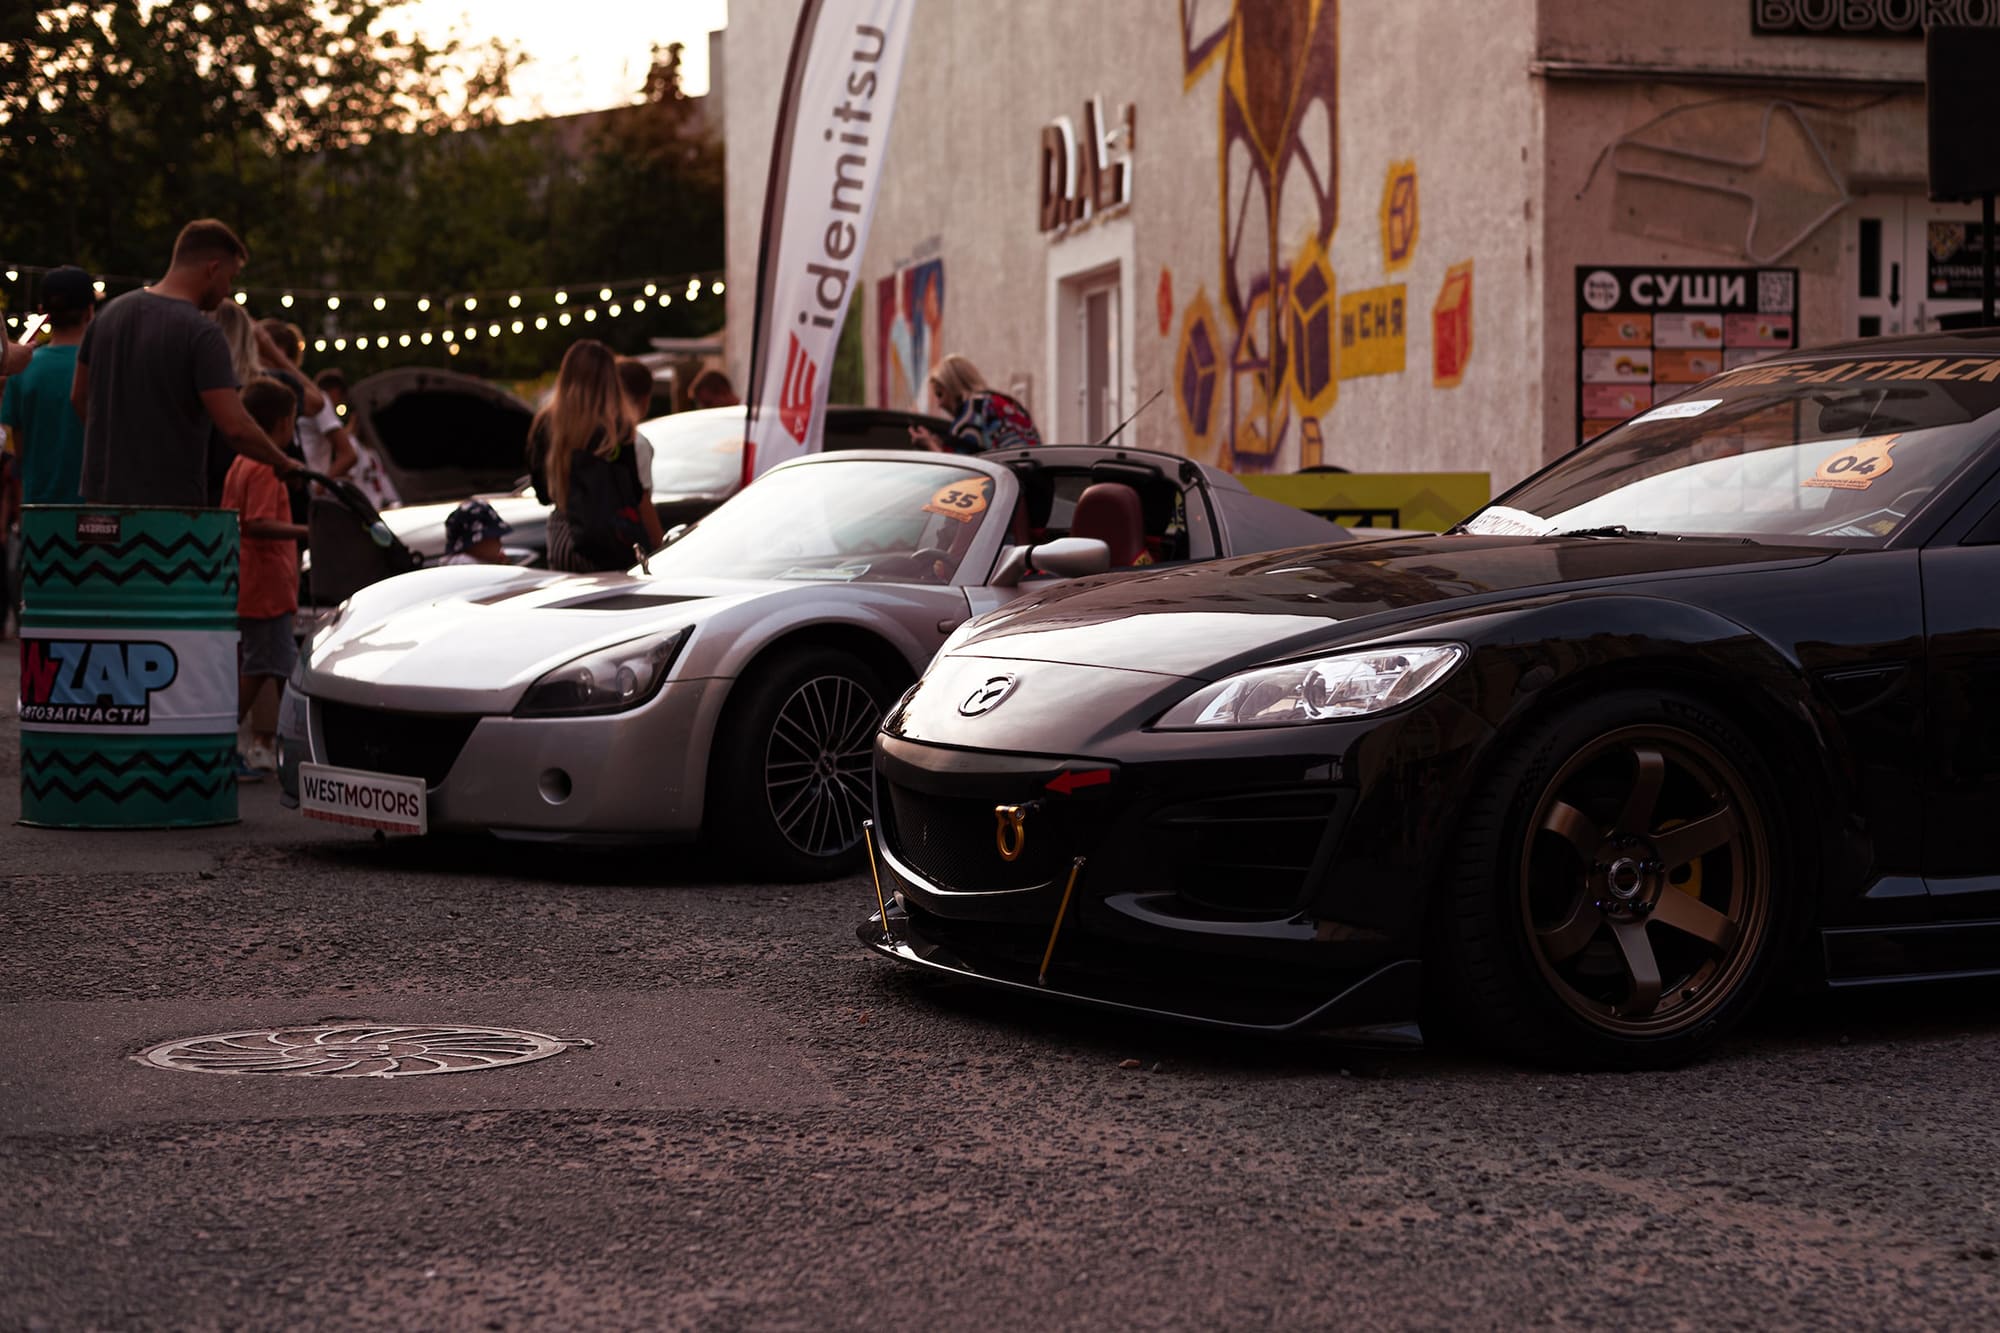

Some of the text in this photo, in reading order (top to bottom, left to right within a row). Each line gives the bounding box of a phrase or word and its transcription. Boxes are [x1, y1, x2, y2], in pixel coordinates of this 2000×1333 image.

[799, 24, 886, 329] idemitsu
[1630, 273, 1747, 307] СУШИ
[1826, 455, 1878, 475] 04
[940, 490, 978, 508] 35
[304, 776, 419, 817] WESTMOTORS
